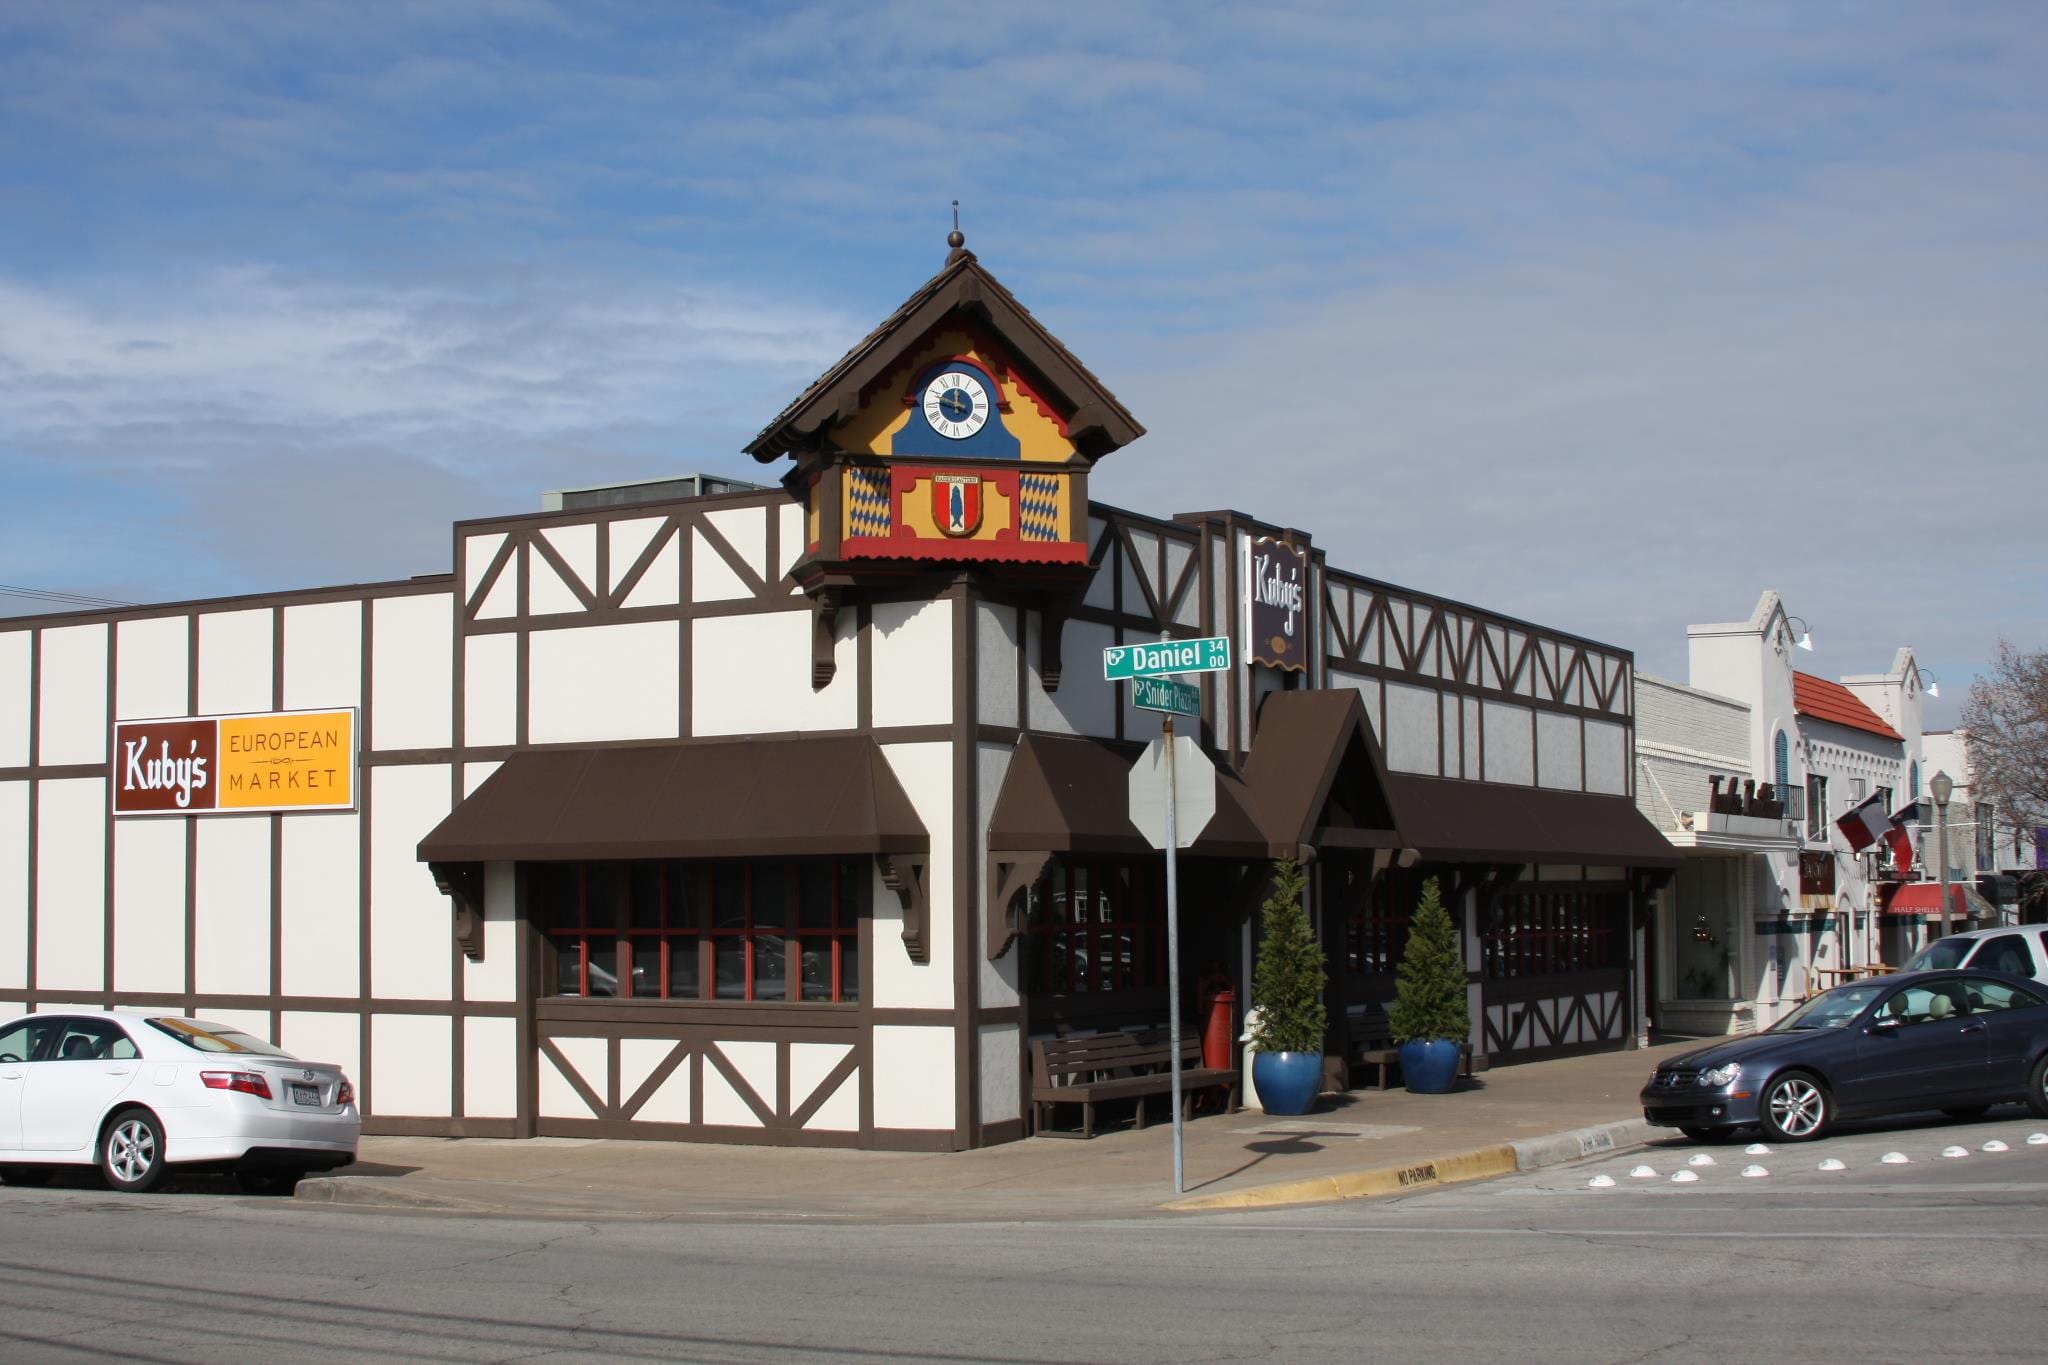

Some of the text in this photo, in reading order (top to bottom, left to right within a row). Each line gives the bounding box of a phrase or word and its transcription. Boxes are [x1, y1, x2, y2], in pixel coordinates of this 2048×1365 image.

[1255, 554, 1302, 636] Kuby's
[1133, 643, 1200, 670] Daniel
[1208, 641, 1224, 652] 34
[1209, 656, 1225, 668] 00
[1146, 680, 1173, 708] Snider
[230, 730, 338, 753] EUROPEAN
[123, 736, 207, 807] Kuby's
[230, 769, 337, 791] MARKET
[1398, 1164, 1436, 1186] NO PARKING
